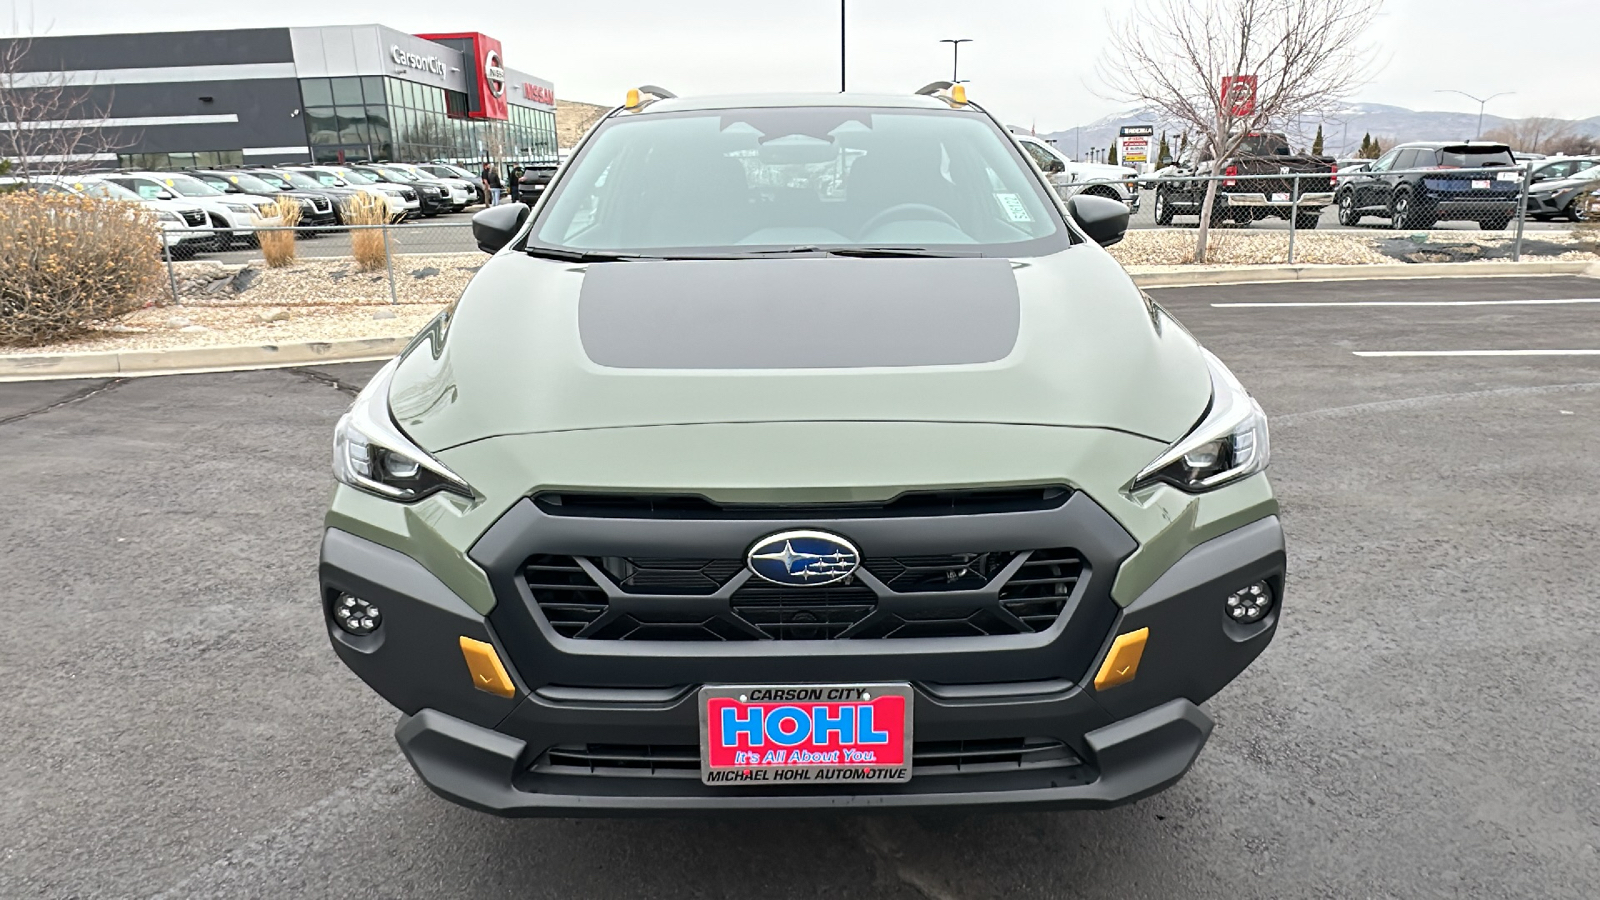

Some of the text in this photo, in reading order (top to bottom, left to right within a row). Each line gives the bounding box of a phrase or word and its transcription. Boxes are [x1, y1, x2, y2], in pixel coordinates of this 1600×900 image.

[391, 45, 447, 80] Carson City
[524, 83, 554, 106] NISSAN
[750, 688, 866, 701] CARSON CITY
[721, 705, 889, 747] HOHL
[735, 748, 877, 764] It's All About You.
[707, 768, 907, 782] MICHAEL HOHL AUTOMOTIVE
